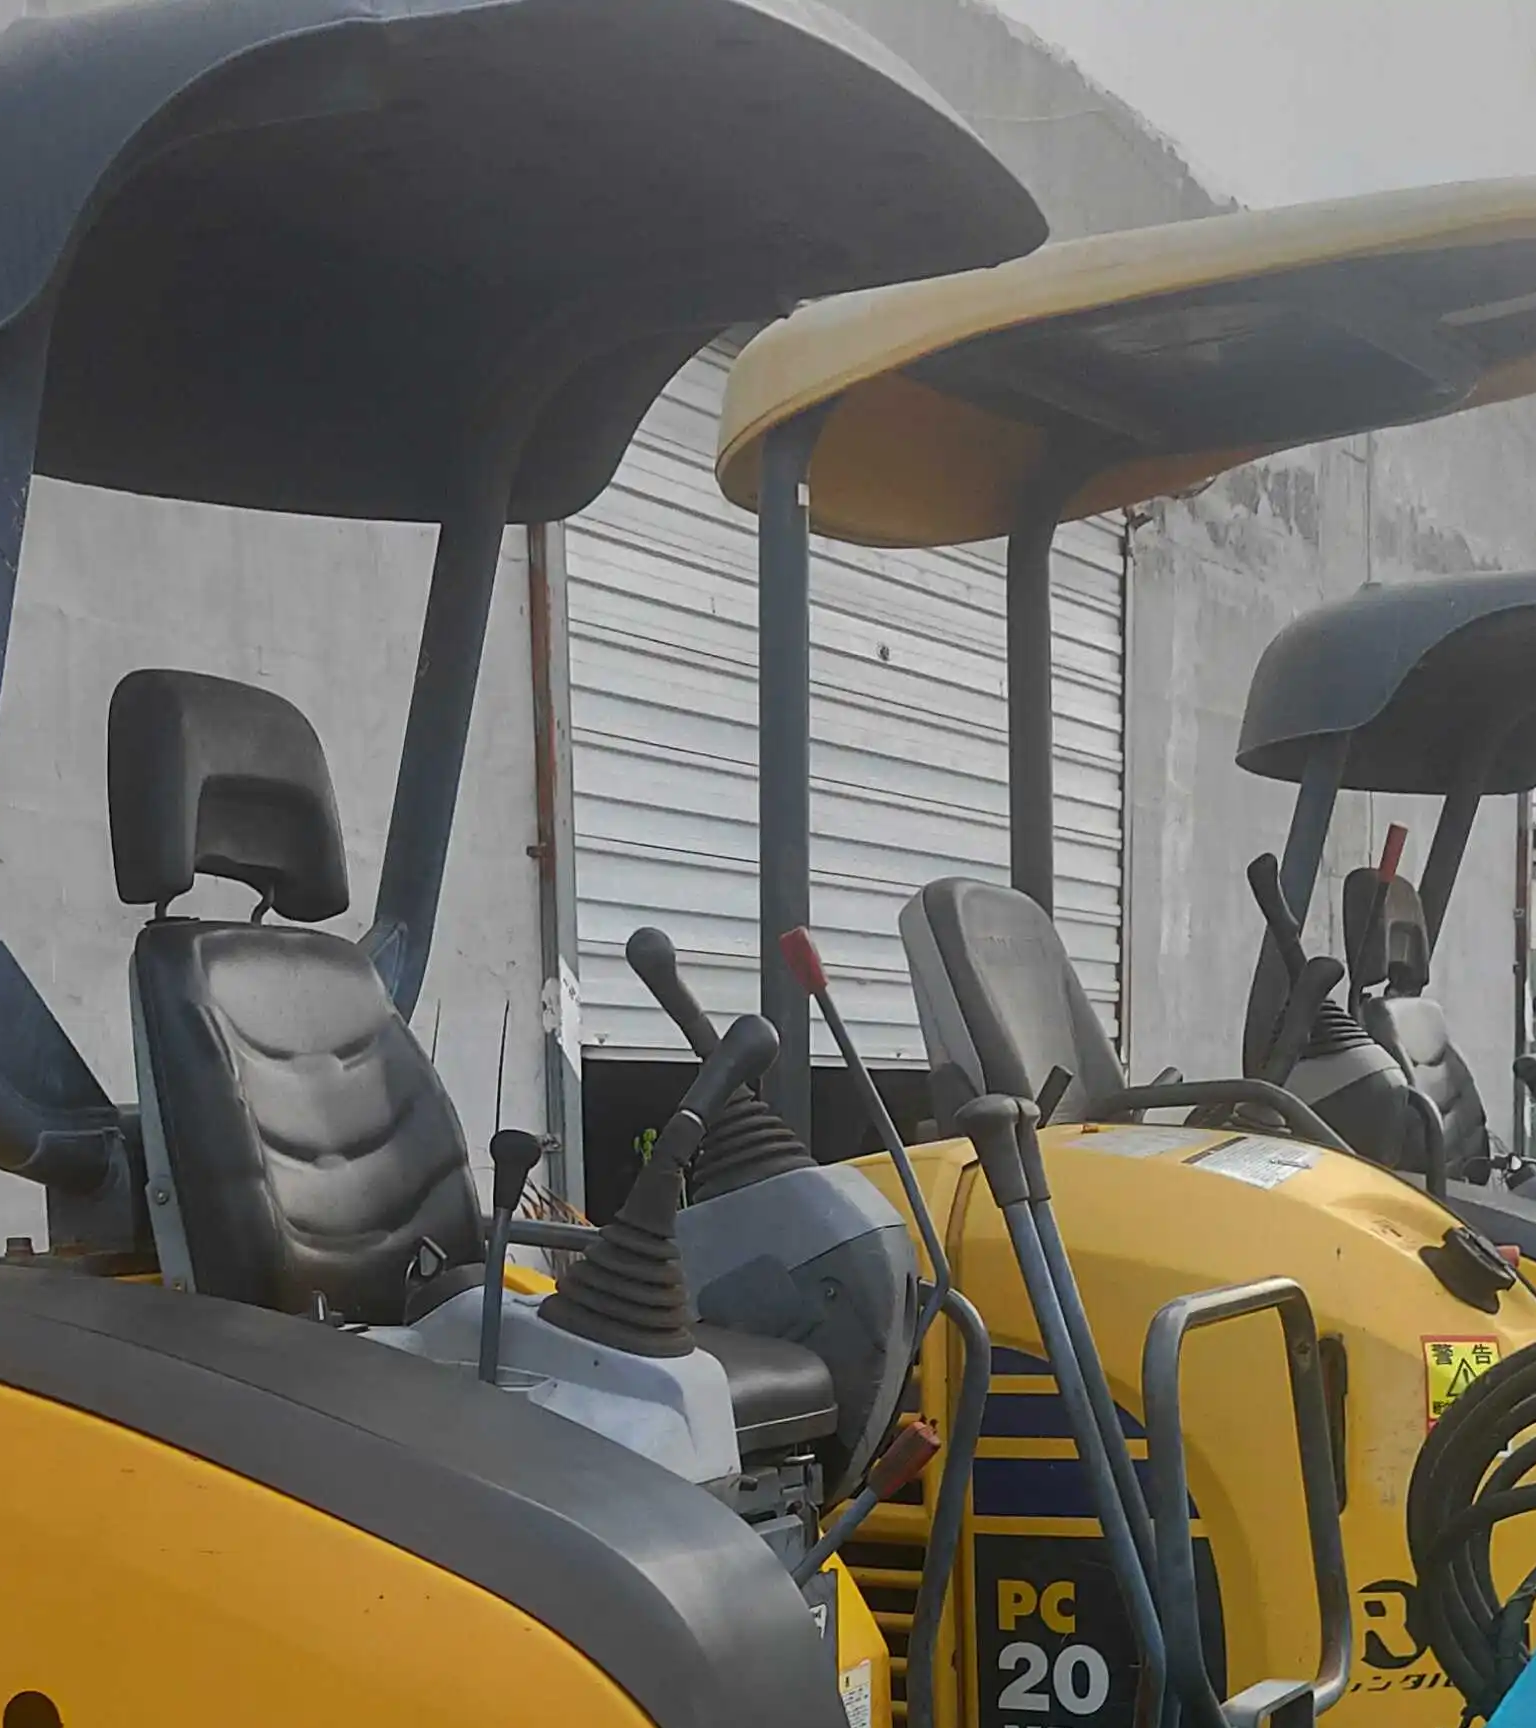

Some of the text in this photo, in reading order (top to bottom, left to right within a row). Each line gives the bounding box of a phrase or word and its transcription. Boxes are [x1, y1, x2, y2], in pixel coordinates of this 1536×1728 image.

[1431, 1344, 1493, 1365] 警告
[997, 1579, 1076, 1634] PC
[997, 1641, 1110, 1715] 20
